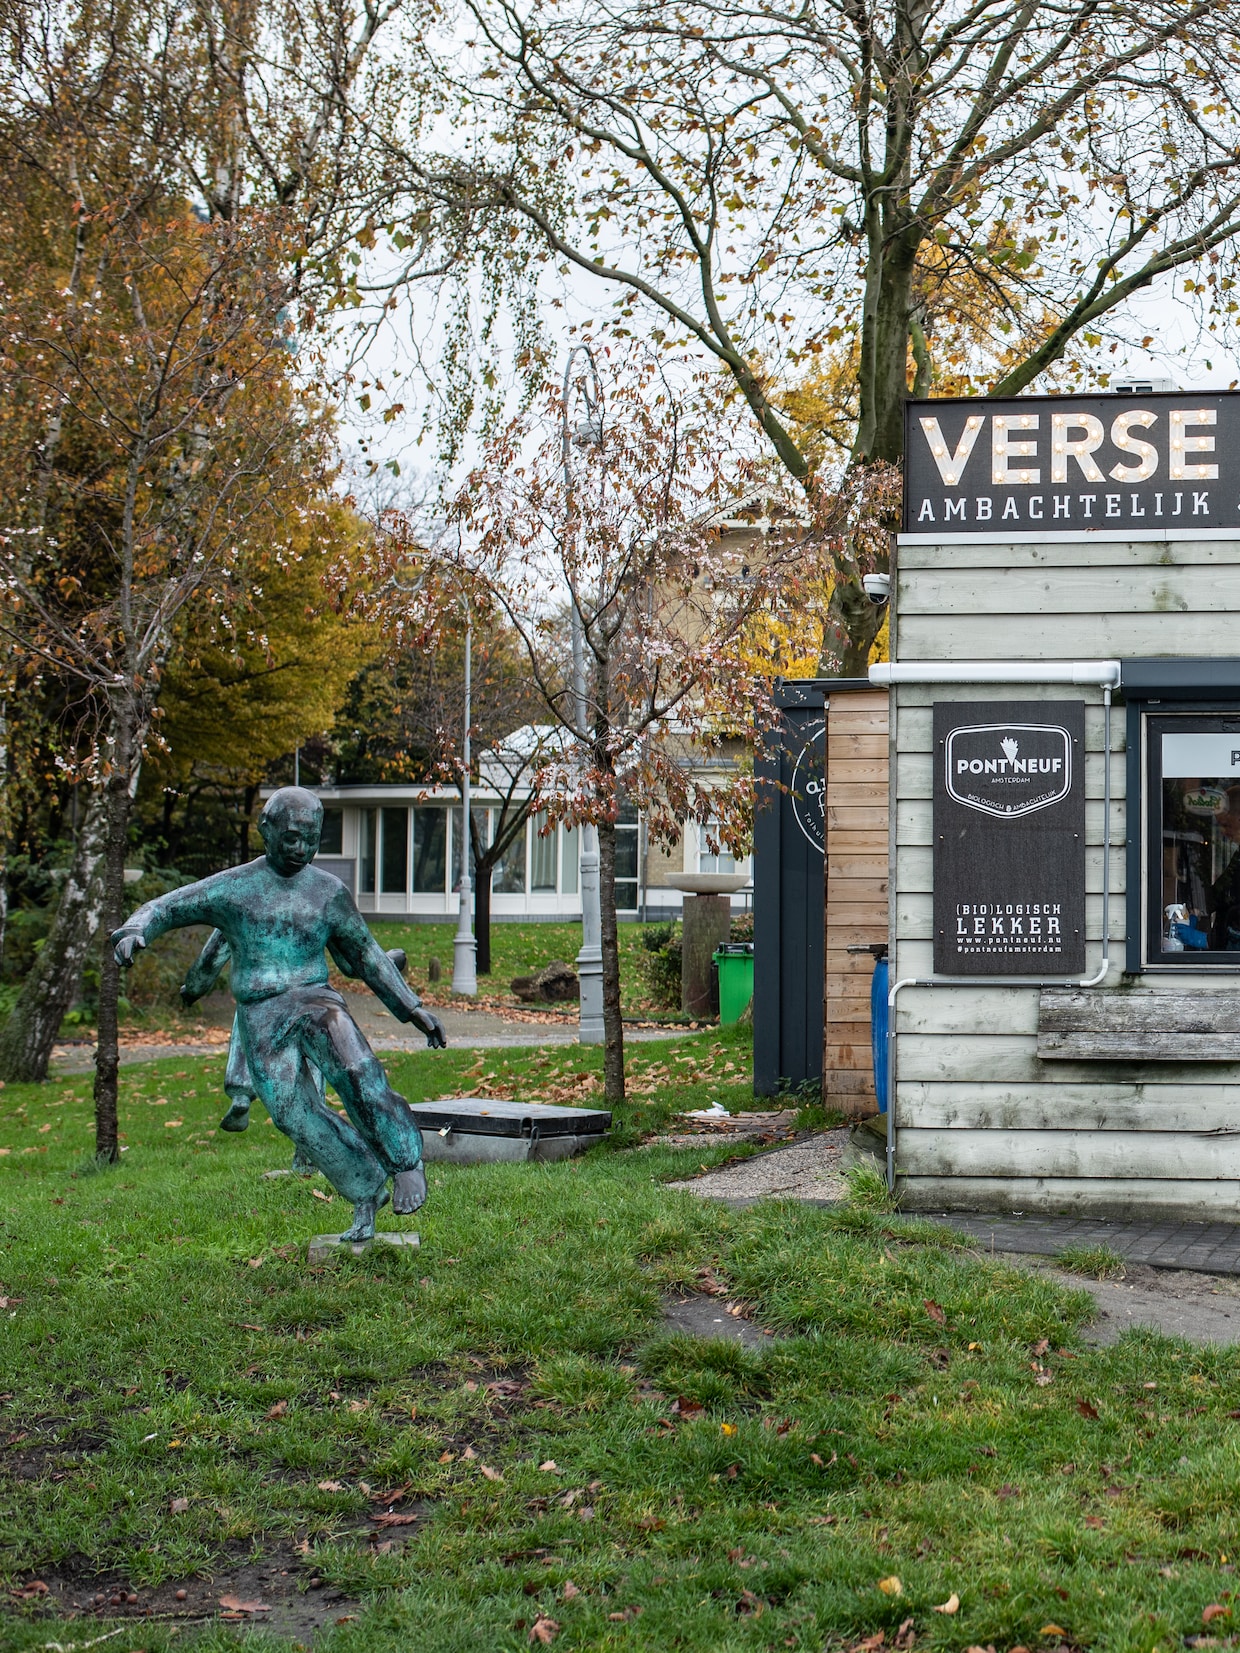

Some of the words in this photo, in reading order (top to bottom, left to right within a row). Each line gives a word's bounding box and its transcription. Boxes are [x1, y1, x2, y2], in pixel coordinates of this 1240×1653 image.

[919, 409, 1220, 486] VERSE
[918, 491, 1210, 522] AMBACHTELIJK
[957, 759, 1009, 774] PONT
[1014, 758, 1063, 774] NEUF
[804, 812, 825, 842] Tolhui
[956, 903, 1061, 915] (BIO)LOGISCH
[956, 917, 1061, 935] LEKKER
[957, 936, 1062, 945] www.pontneuf.nu
